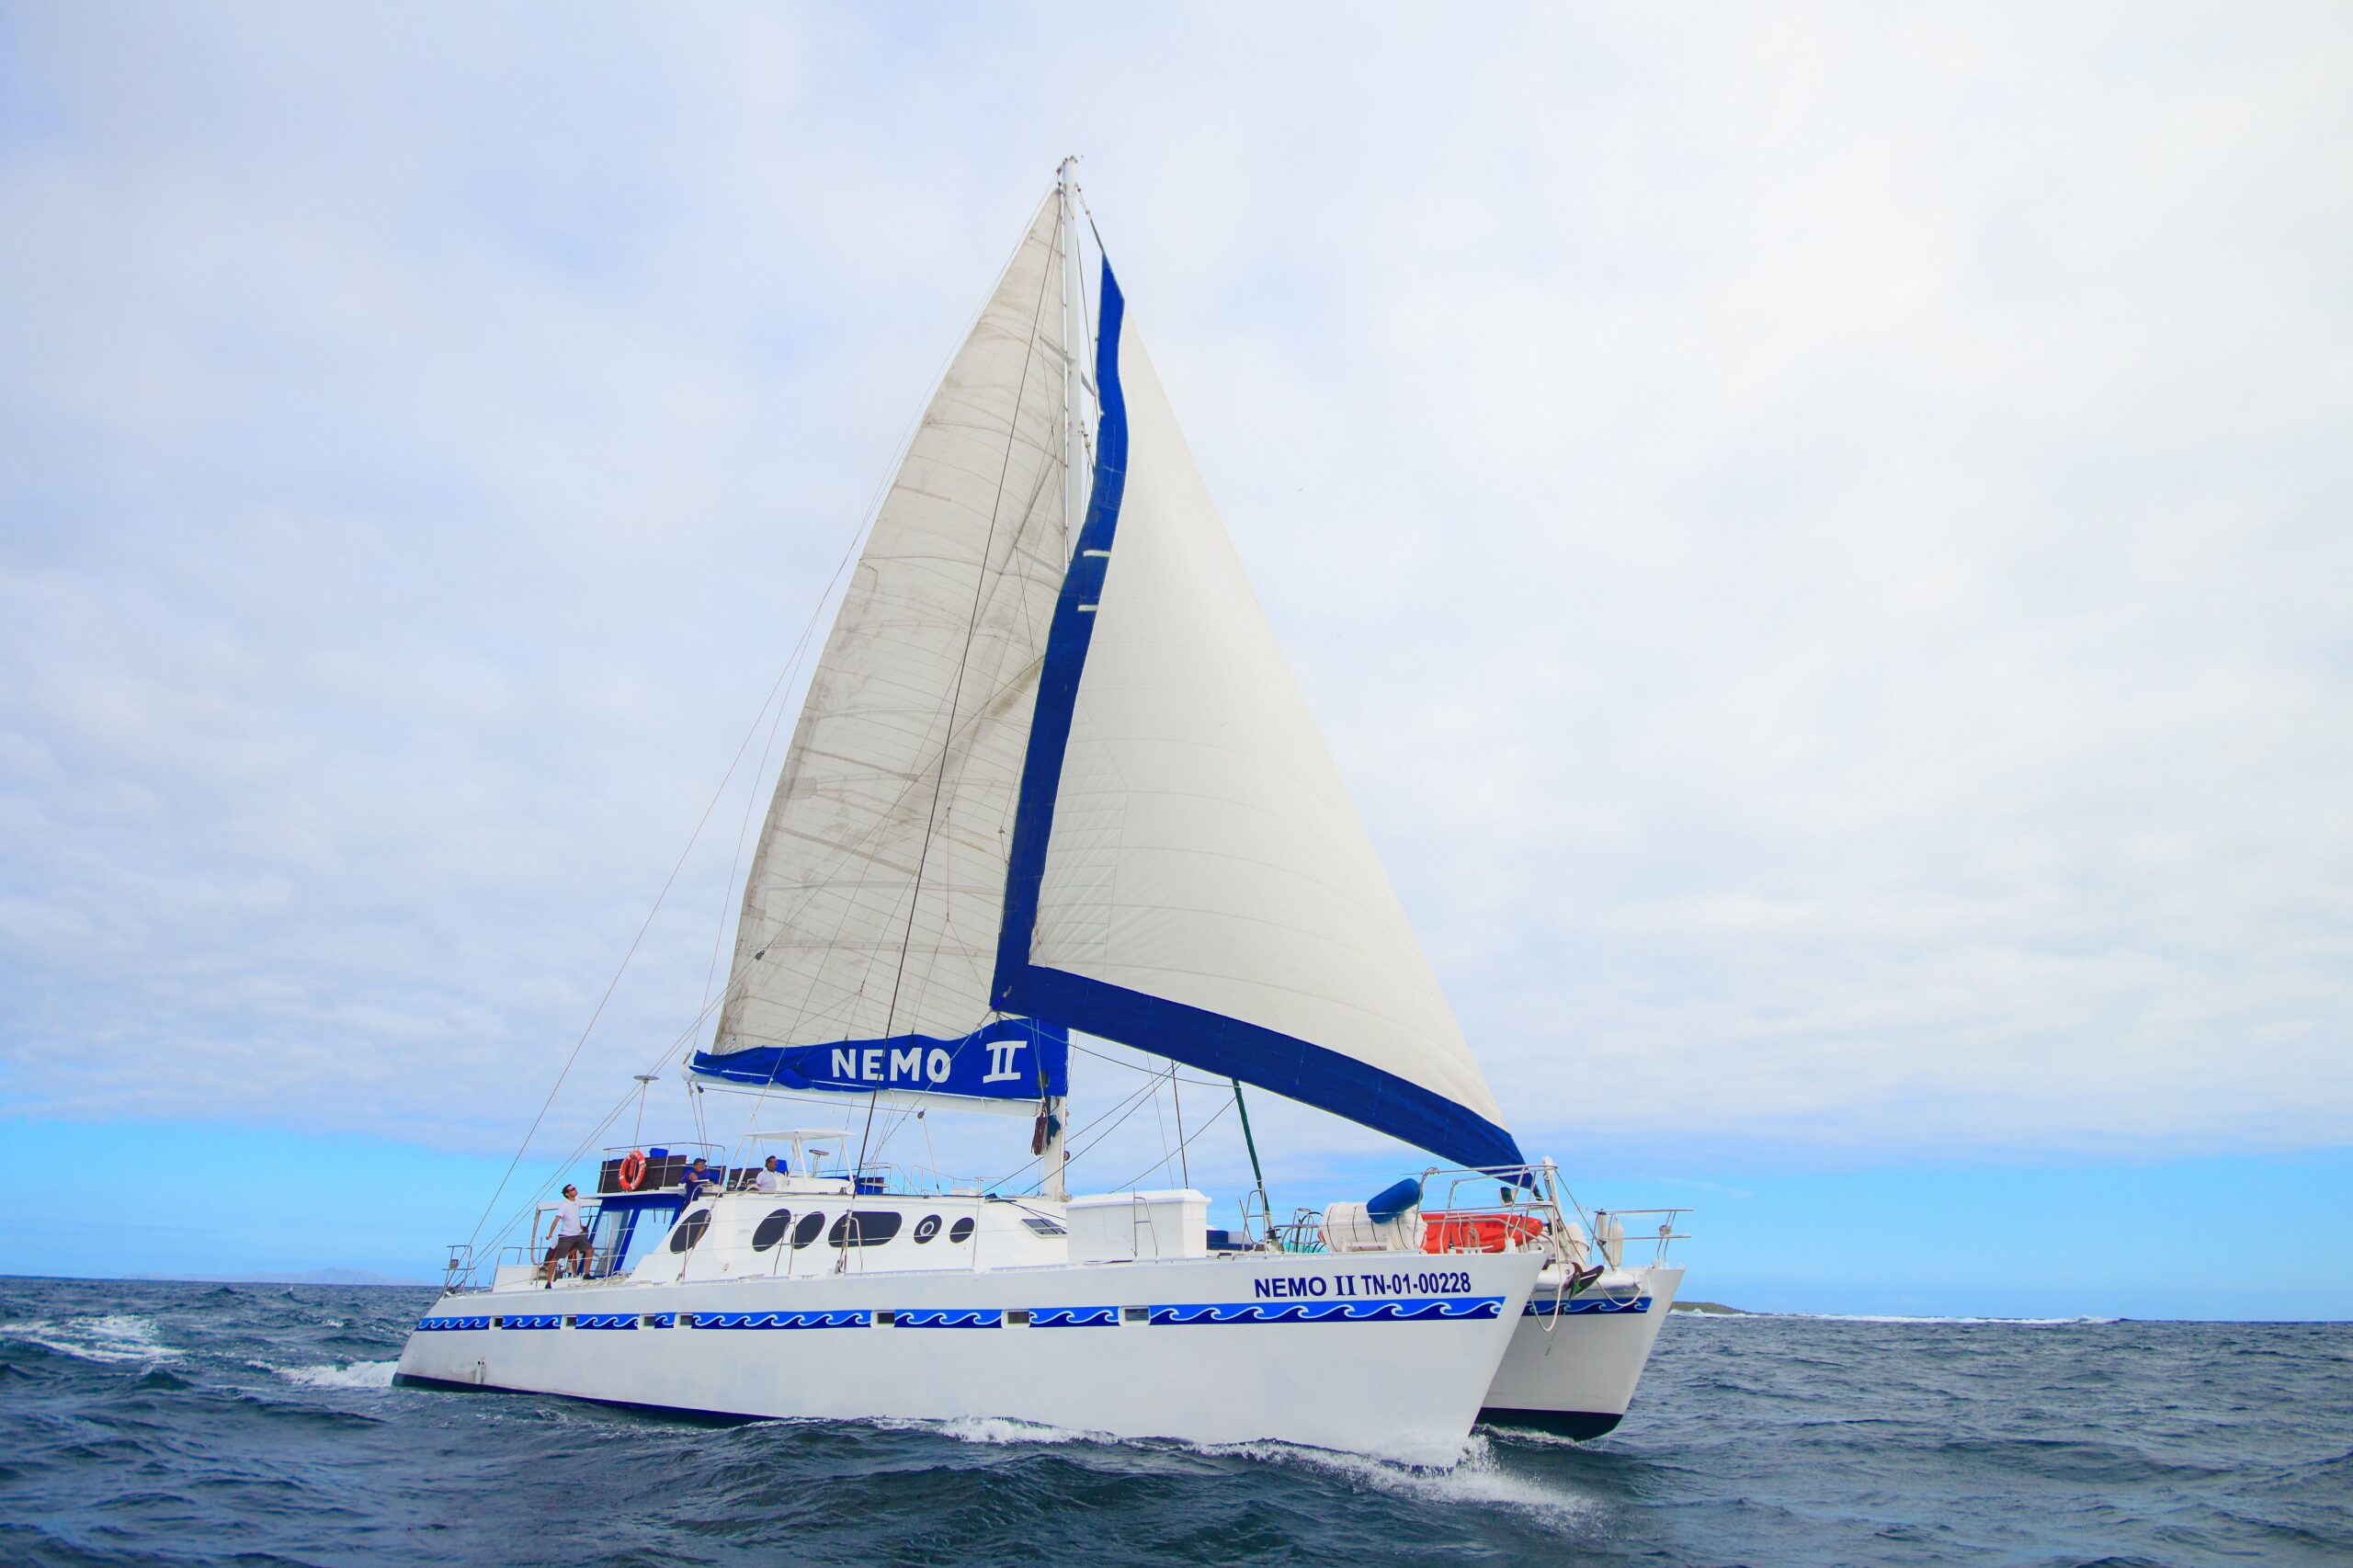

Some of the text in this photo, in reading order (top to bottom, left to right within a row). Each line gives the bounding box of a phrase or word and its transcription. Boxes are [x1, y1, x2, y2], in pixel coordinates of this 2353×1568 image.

[831, 1040, 1028, 1084] NEMO II
[1254, 1271, 1472, 1298] NEMO II TN-01-00228
